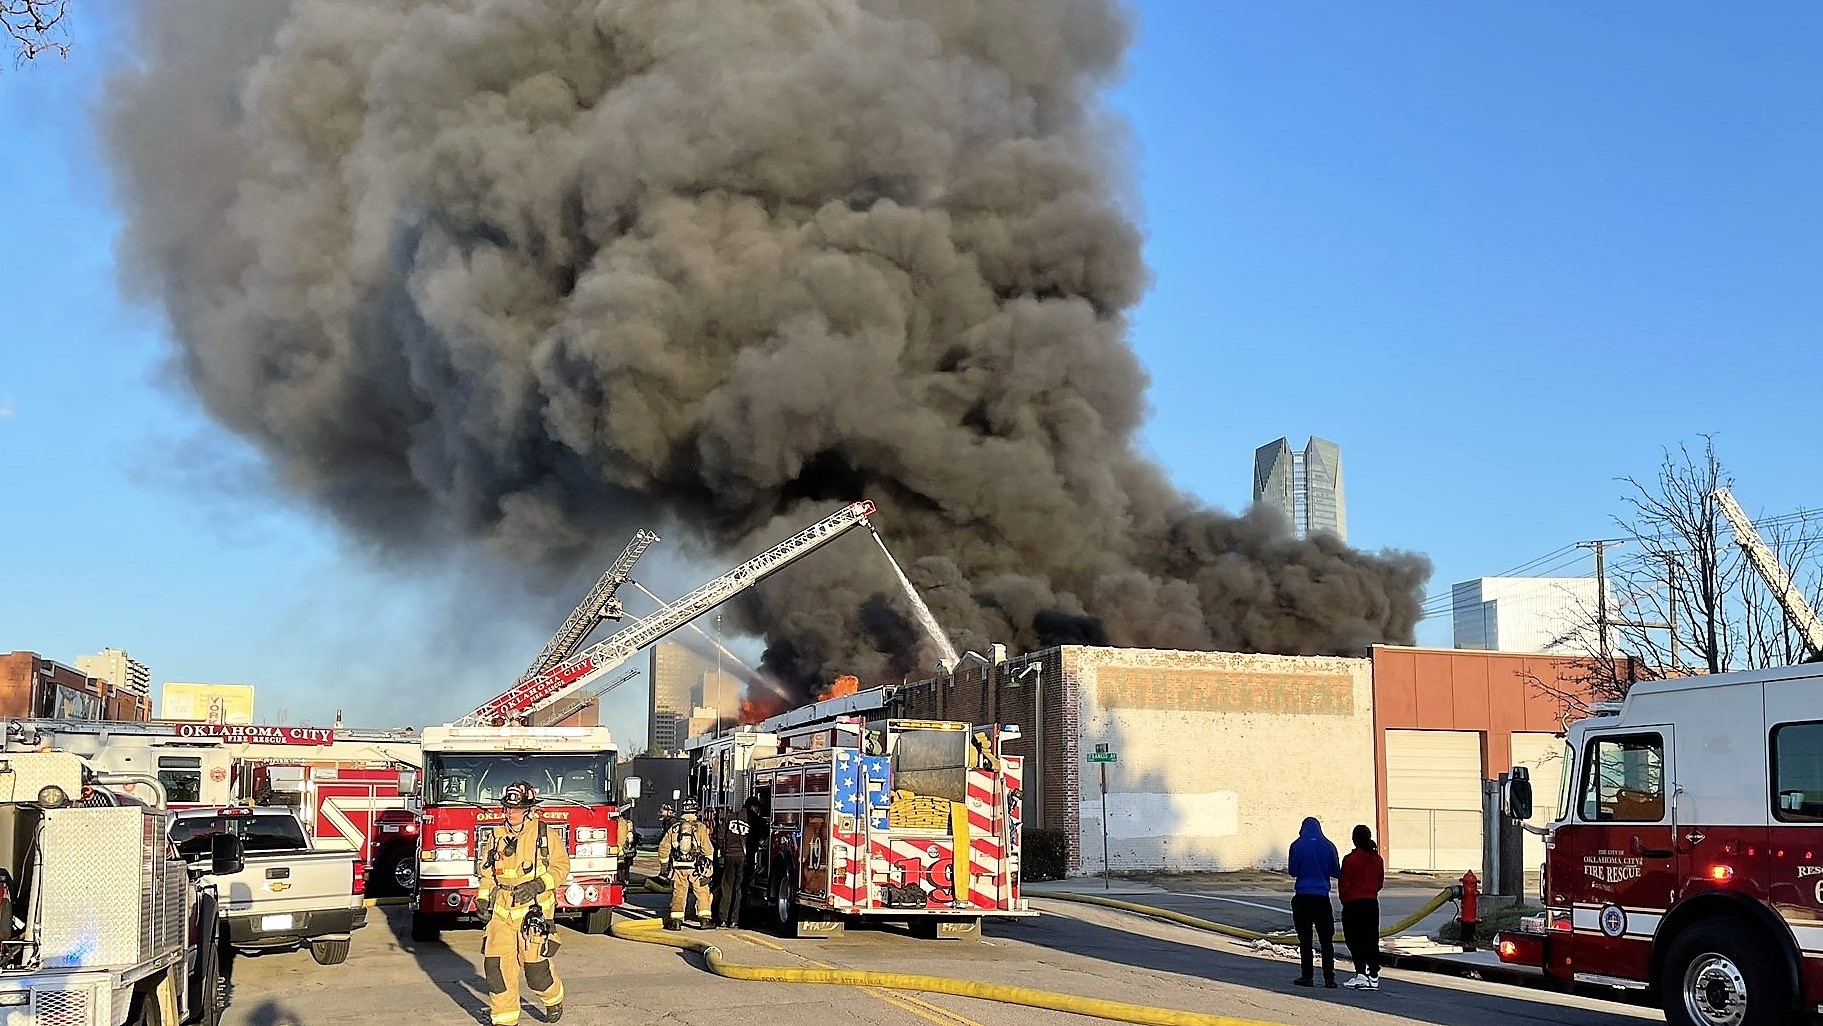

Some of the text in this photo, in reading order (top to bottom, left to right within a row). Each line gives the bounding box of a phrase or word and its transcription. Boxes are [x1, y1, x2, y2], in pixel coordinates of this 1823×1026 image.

[501, 660, 589, 713] OKLAHOMA CITY
[180, 724, 331, 742] OKLAHOMA CITY
[227, 735, 287, 744] FIRE RESCUE
[476, 811, 569, 821] OKLAA CITY
[809, 837, 822, 869] 19
[1583, 855, 1640, 865] OKLAHOMA CITY
[895, 857, 953, 903] 19
[1584, 865, 1641, 883] FIRE RESCUE
